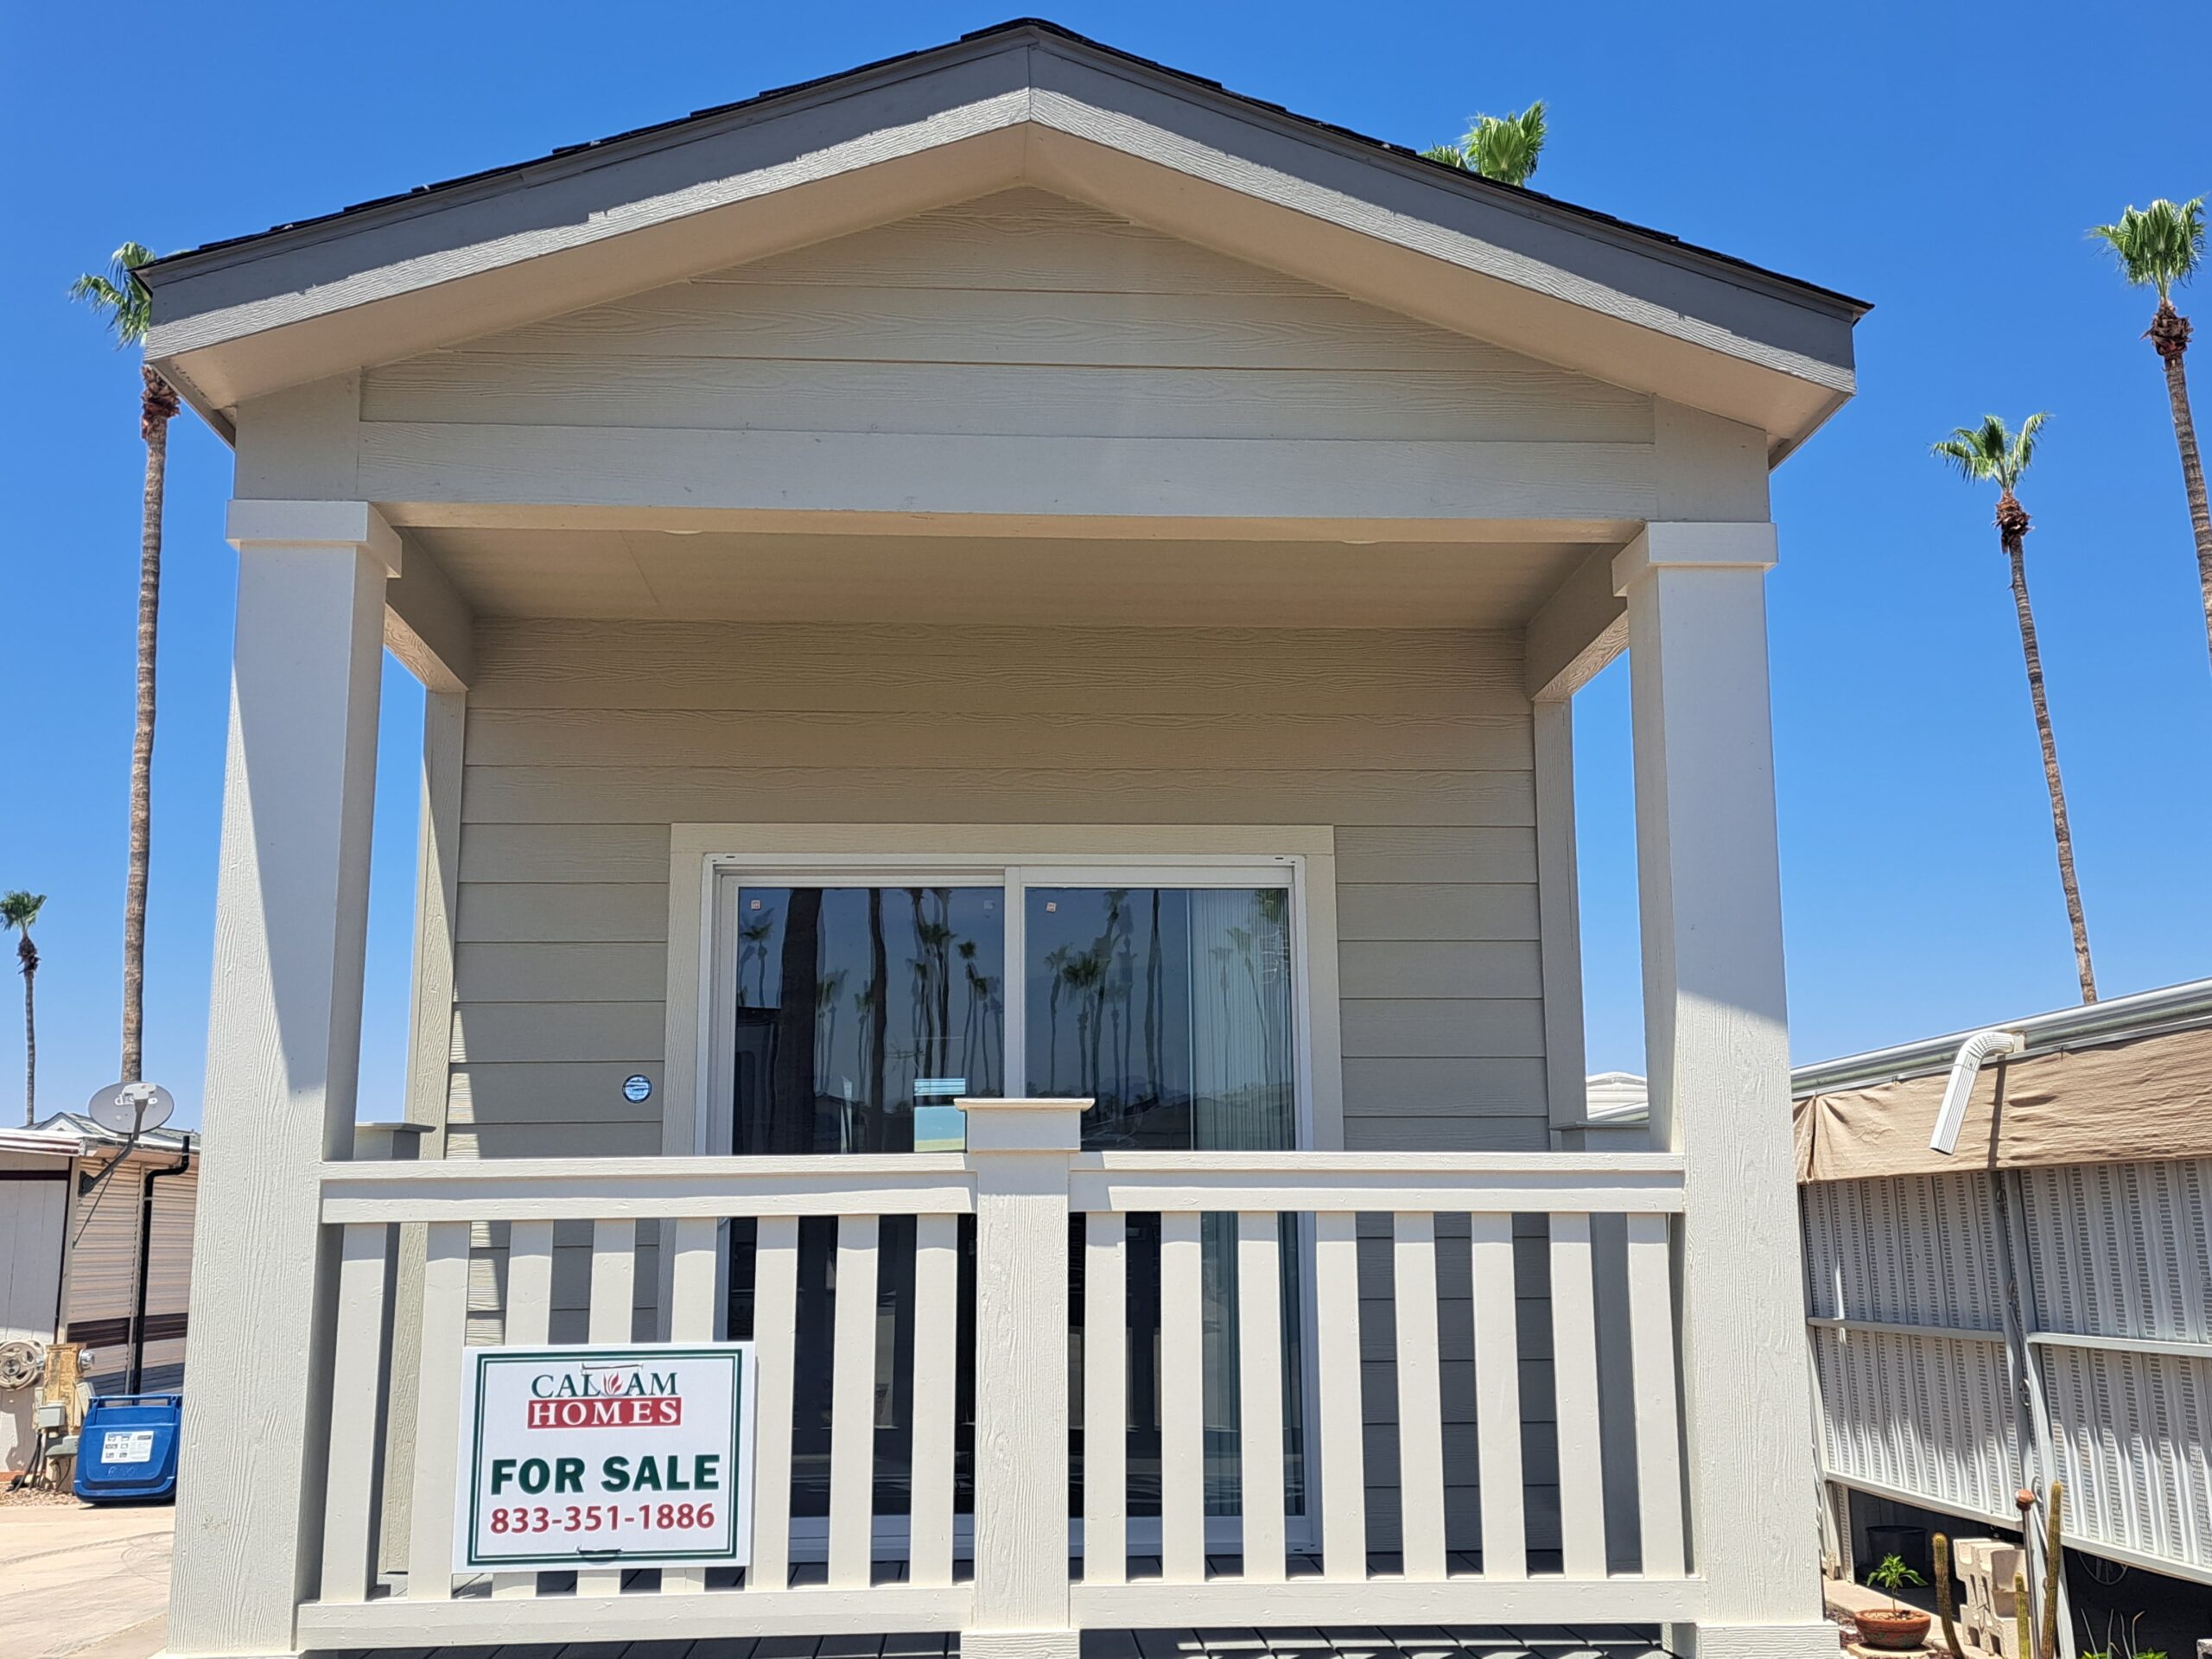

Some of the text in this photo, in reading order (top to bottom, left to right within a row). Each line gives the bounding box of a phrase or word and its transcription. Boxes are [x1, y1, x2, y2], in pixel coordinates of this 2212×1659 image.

[531, 1400, 678, 1426] HOMES
[491, 1454, 720, 1495] FOR SALE
[490, 1503, 715, 1534] 833-351-1886
